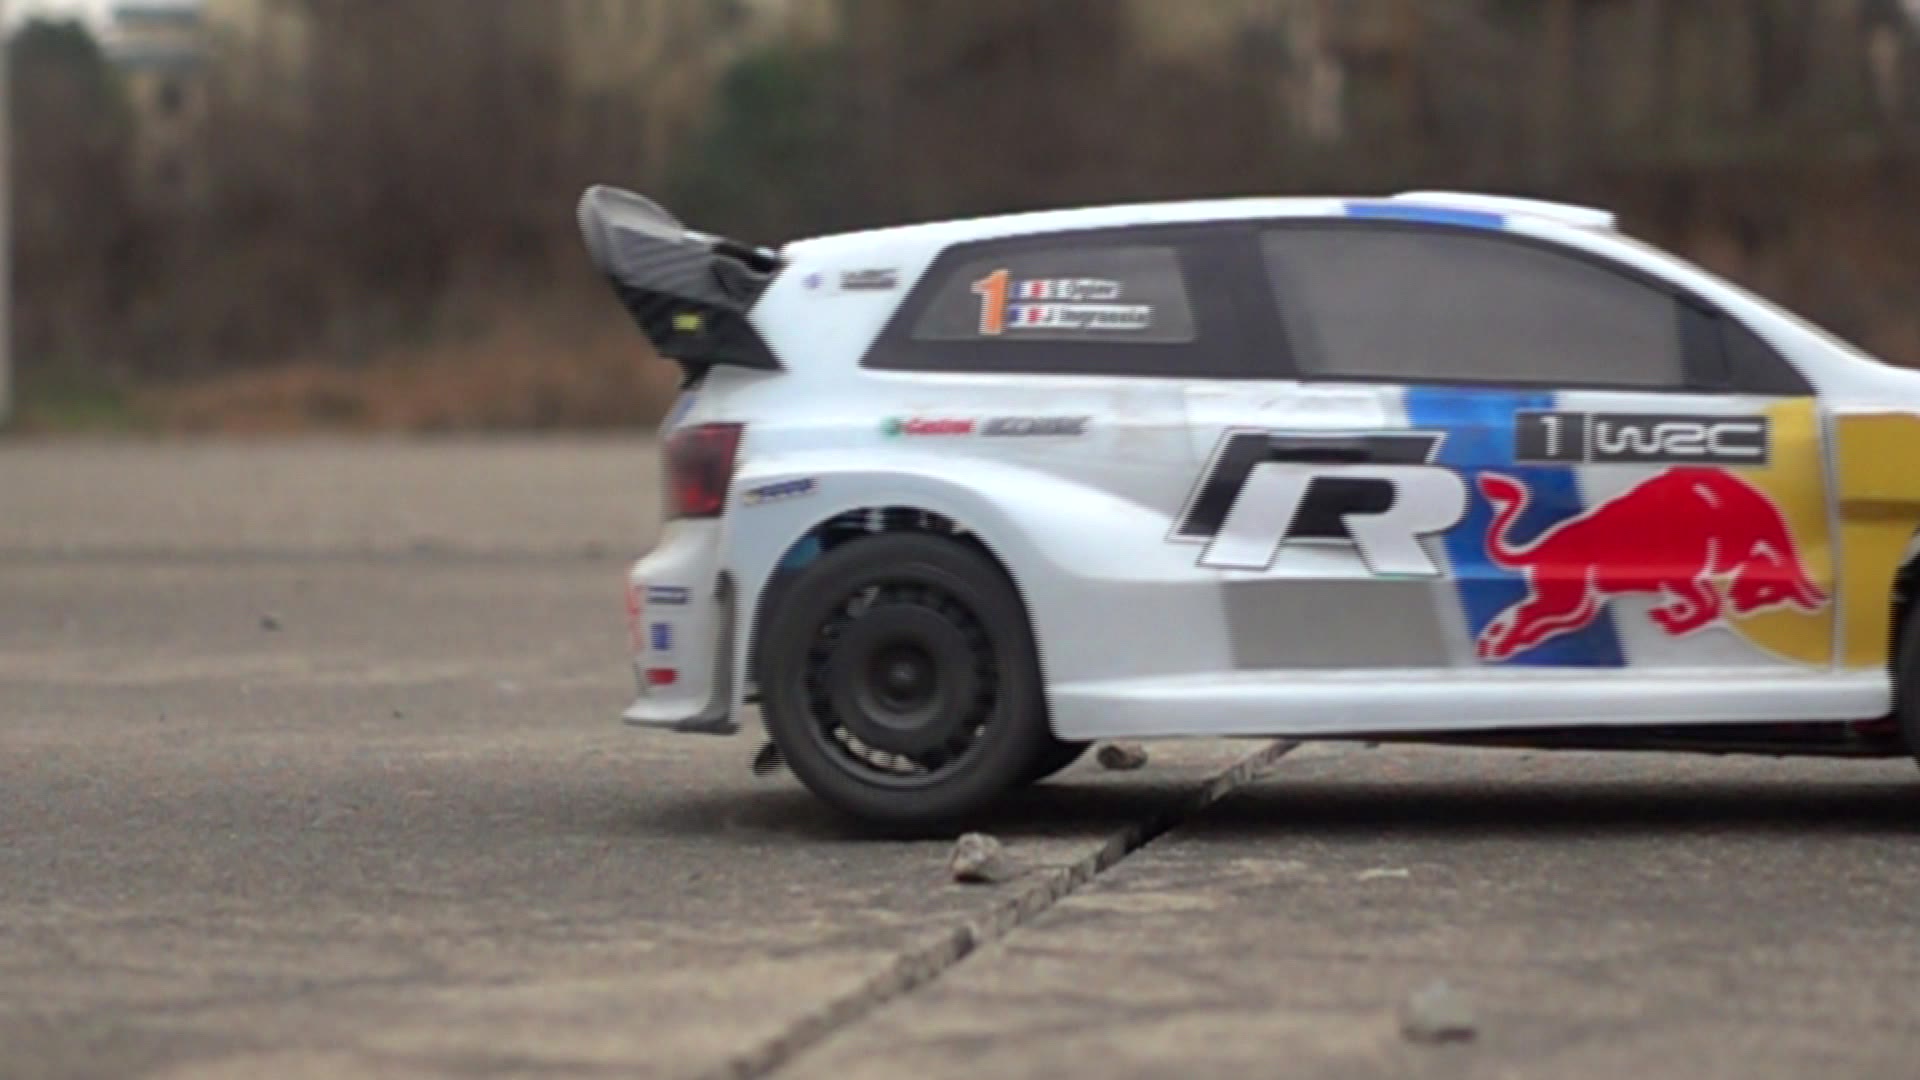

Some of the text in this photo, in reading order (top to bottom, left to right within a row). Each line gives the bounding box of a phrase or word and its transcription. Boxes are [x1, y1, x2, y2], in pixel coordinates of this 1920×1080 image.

[970, 269, 1010, 335] 1
[1540, 415, 1763, 456] 1 WRC
[1195, 461, 1470, 577] R
